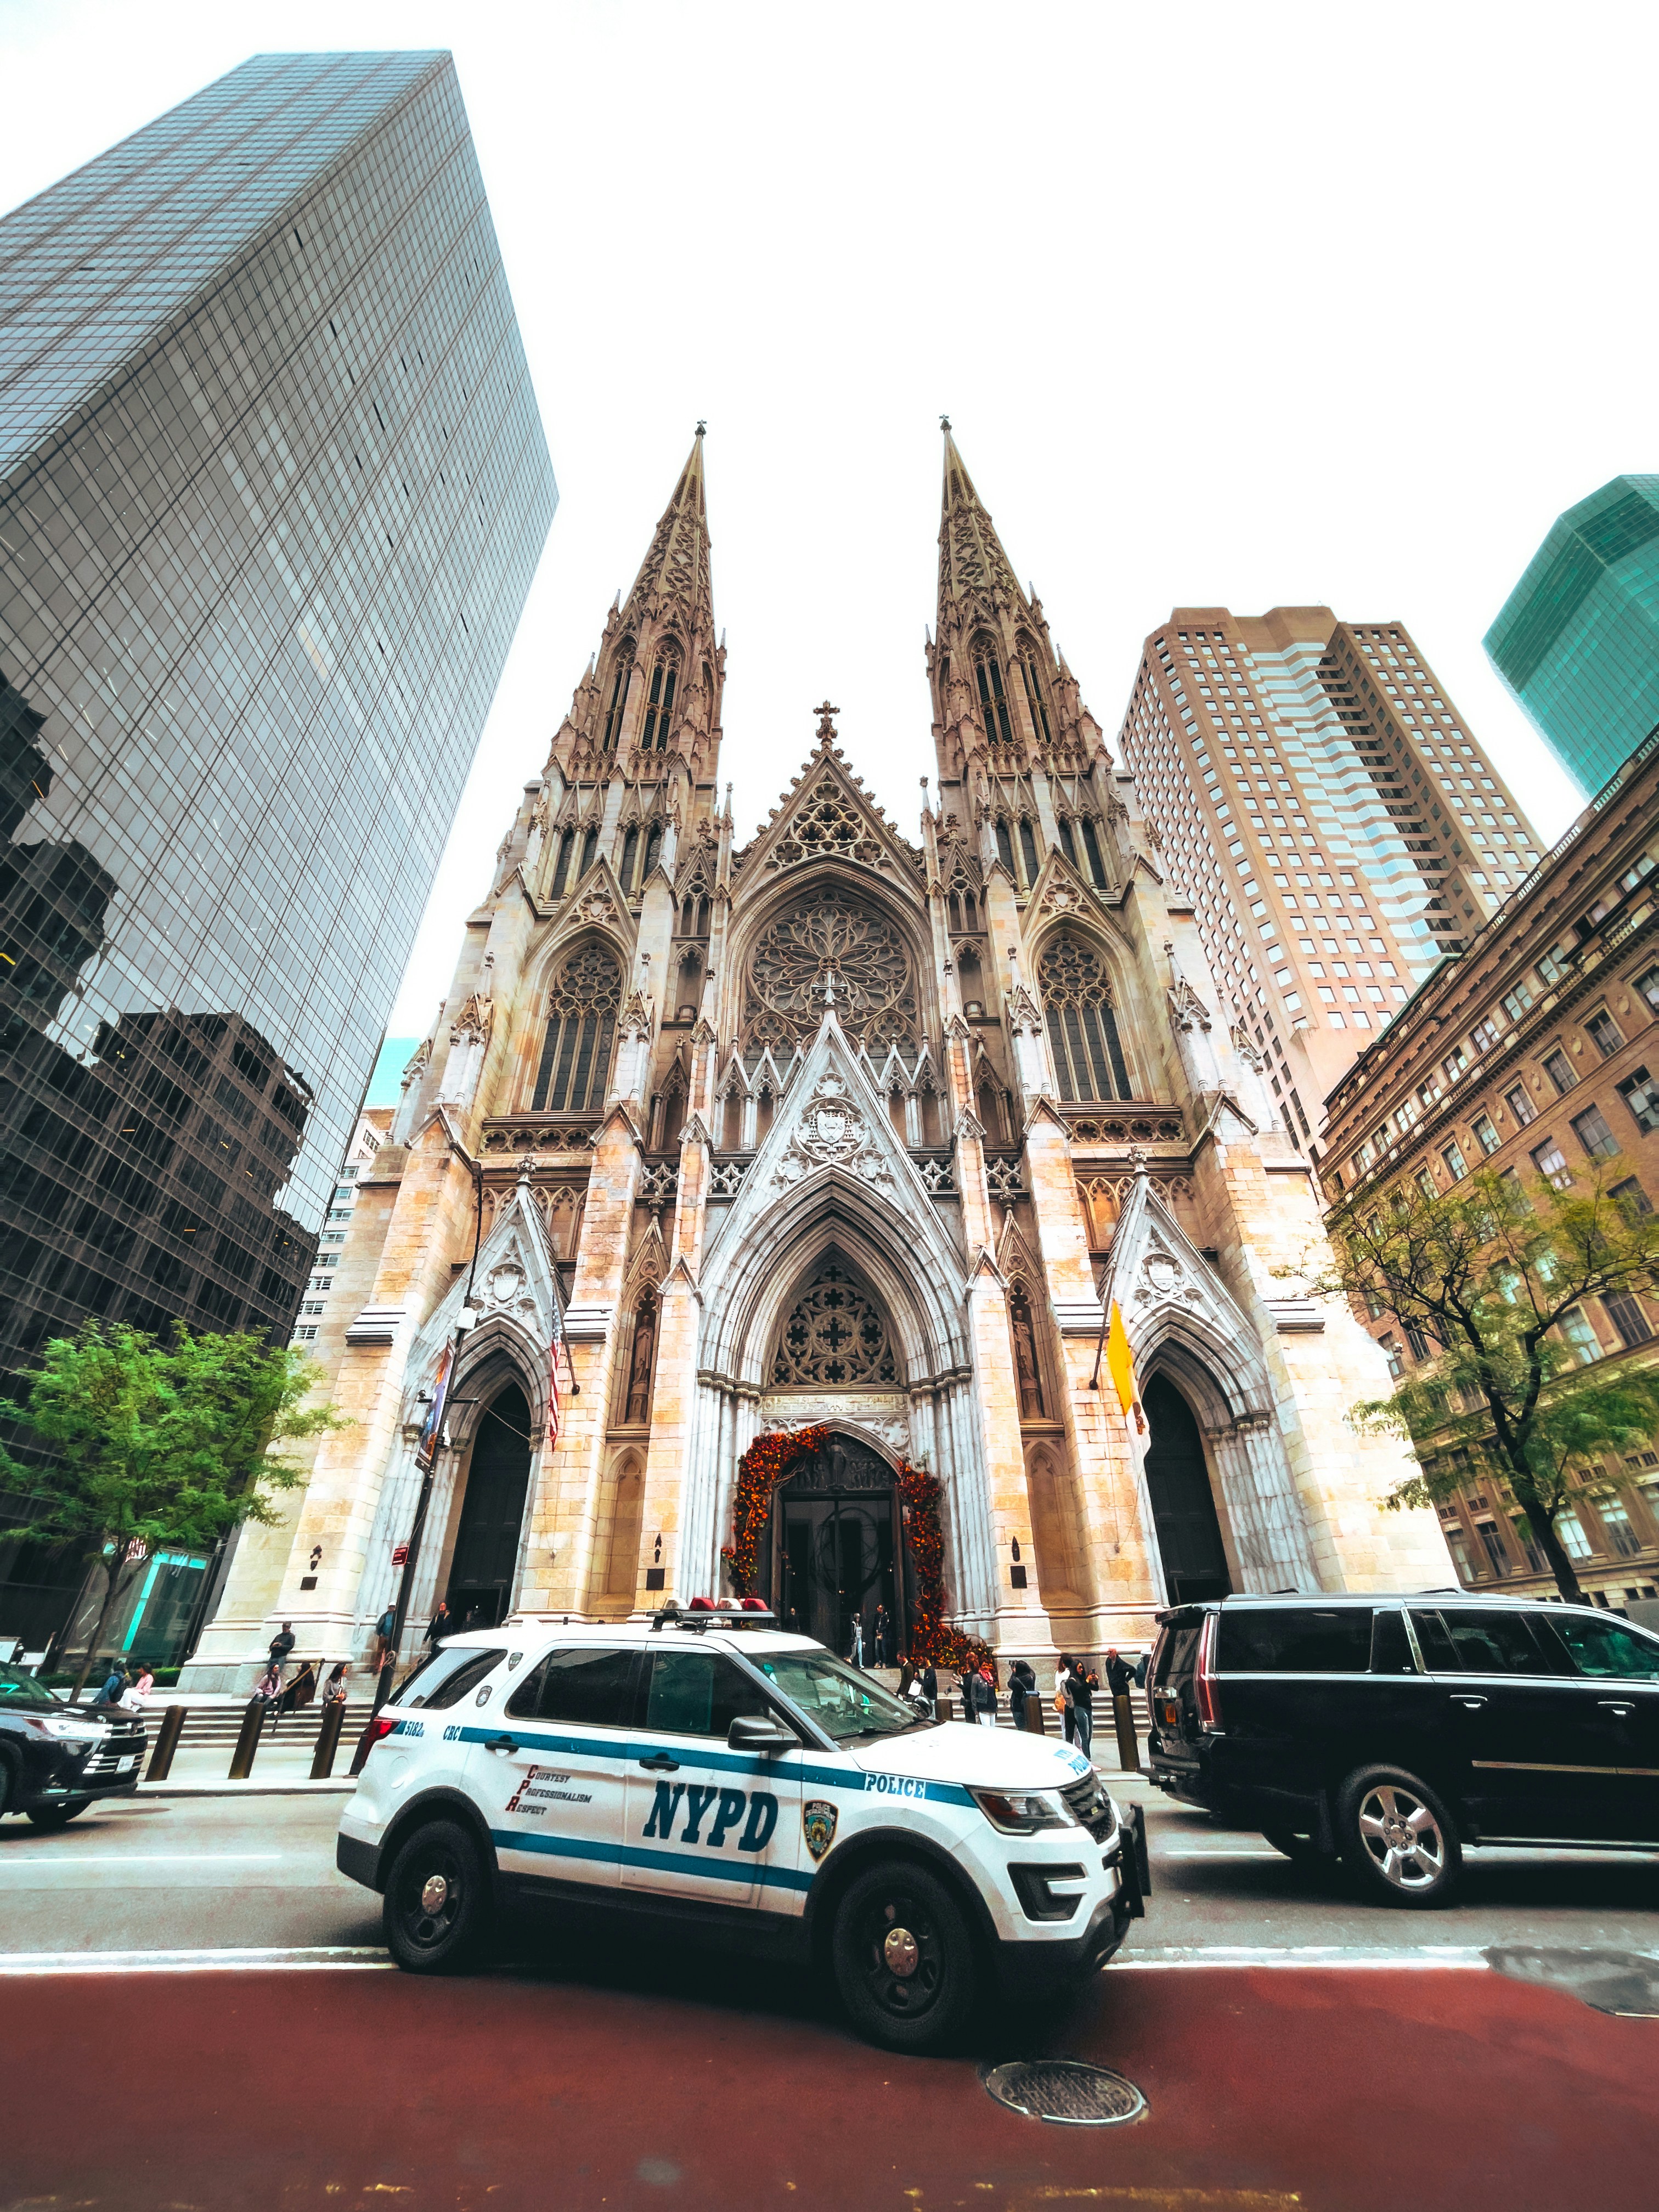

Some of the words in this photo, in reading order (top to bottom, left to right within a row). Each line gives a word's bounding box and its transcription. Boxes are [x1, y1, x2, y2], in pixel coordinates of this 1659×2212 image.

[443, 1725, 461, 1741] CRC
[527, 1764, 571, 1784] COURTESY
[516, 1780, 592, 1803] PROFESSIONALISM
[866, 1773, 925, 1799] POLICE
[505, 1796, 548, 1815] RESPECT
[642, 1780, 778, 1853] NYPD
